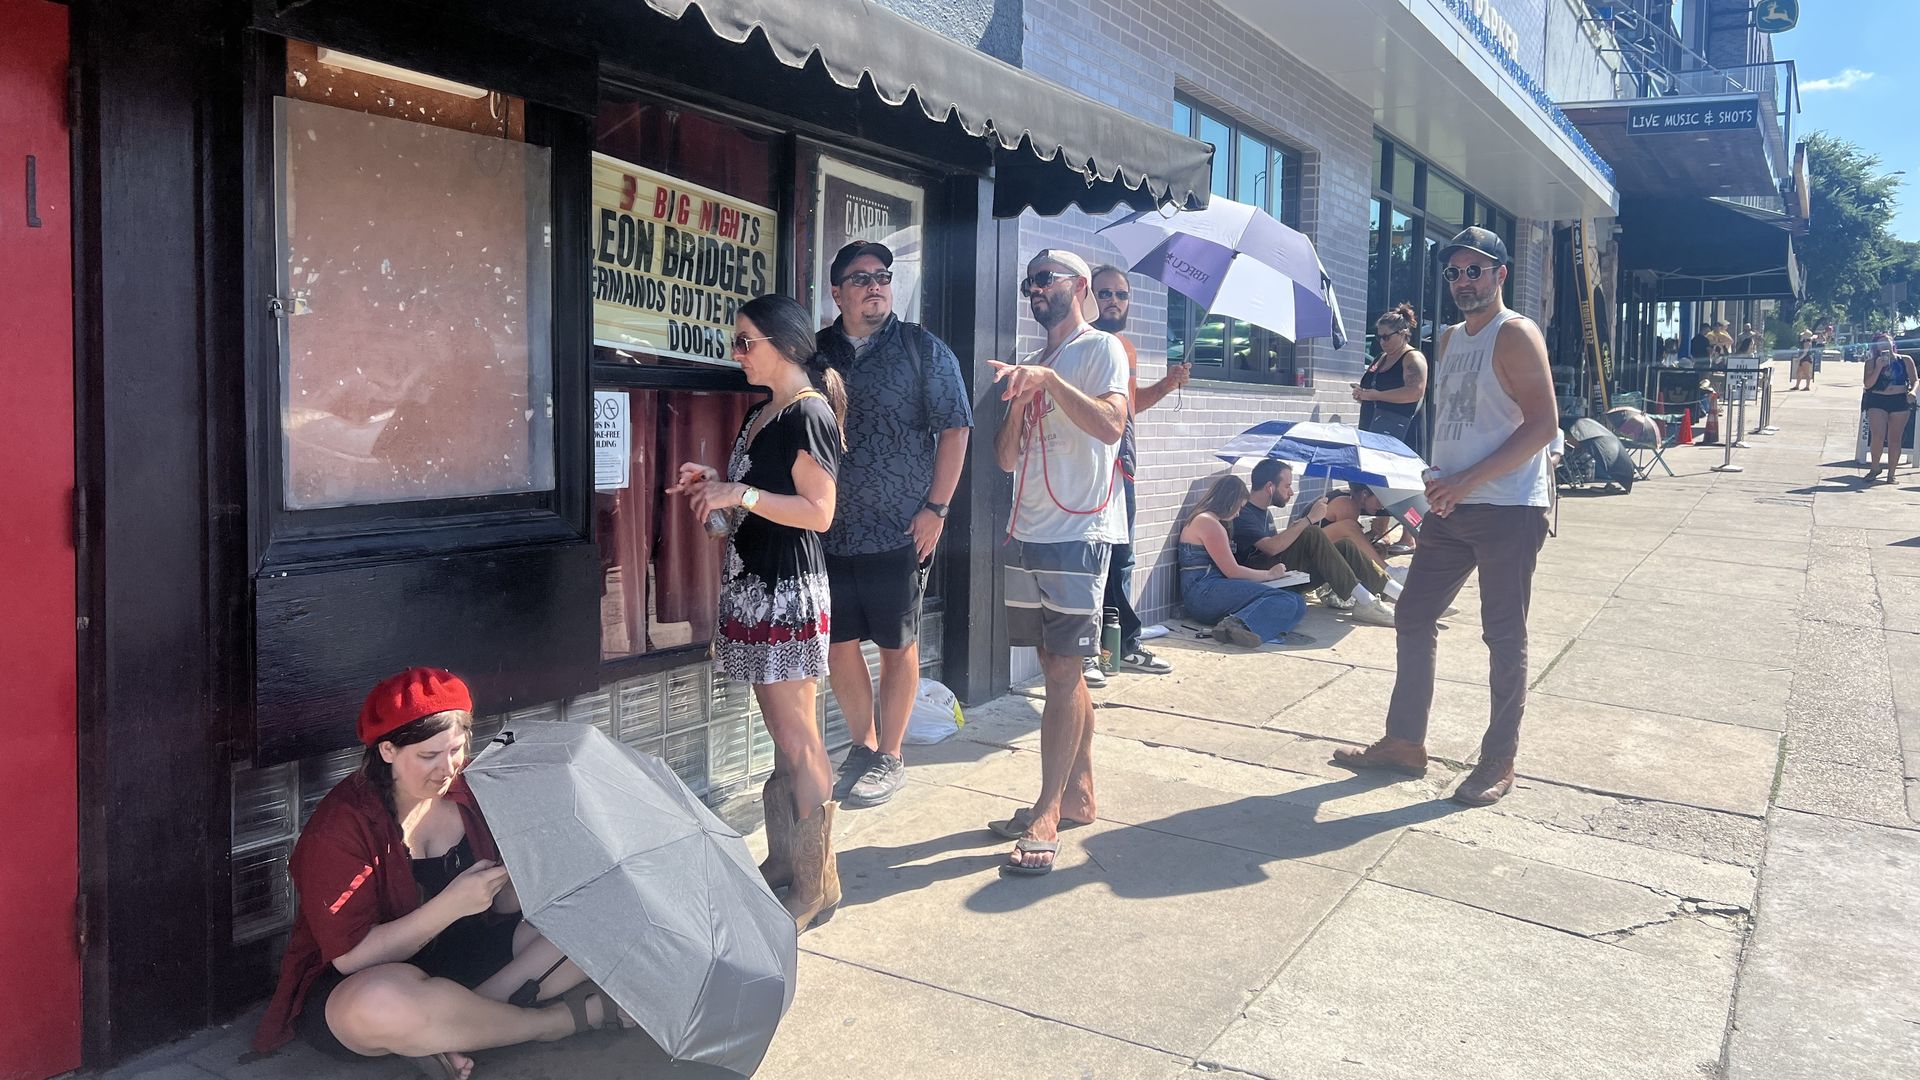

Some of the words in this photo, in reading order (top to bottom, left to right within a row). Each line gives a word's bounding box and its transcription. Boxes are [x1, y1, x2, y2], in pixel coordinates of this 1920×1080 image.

[1632, 113, 1661, 128] LIVE
[1664, 112, 1700, 127] MUSIC
[1704, 110, 1714, 126] &
[1719, 110, 1753, 123] SHOTS
[619, 174, 637, 211] 3
[653, 186, 691, 225] BIG
[699, 200, 761, 246] NIGHTS
[593, 208, 654, 273] EON
[661, 225, 767, 297] BRIDGES
[671, 284, 747, 326] GUTIER
[668, 319, 725, 359] DOORS
[604, 421, 611, 429] IS
